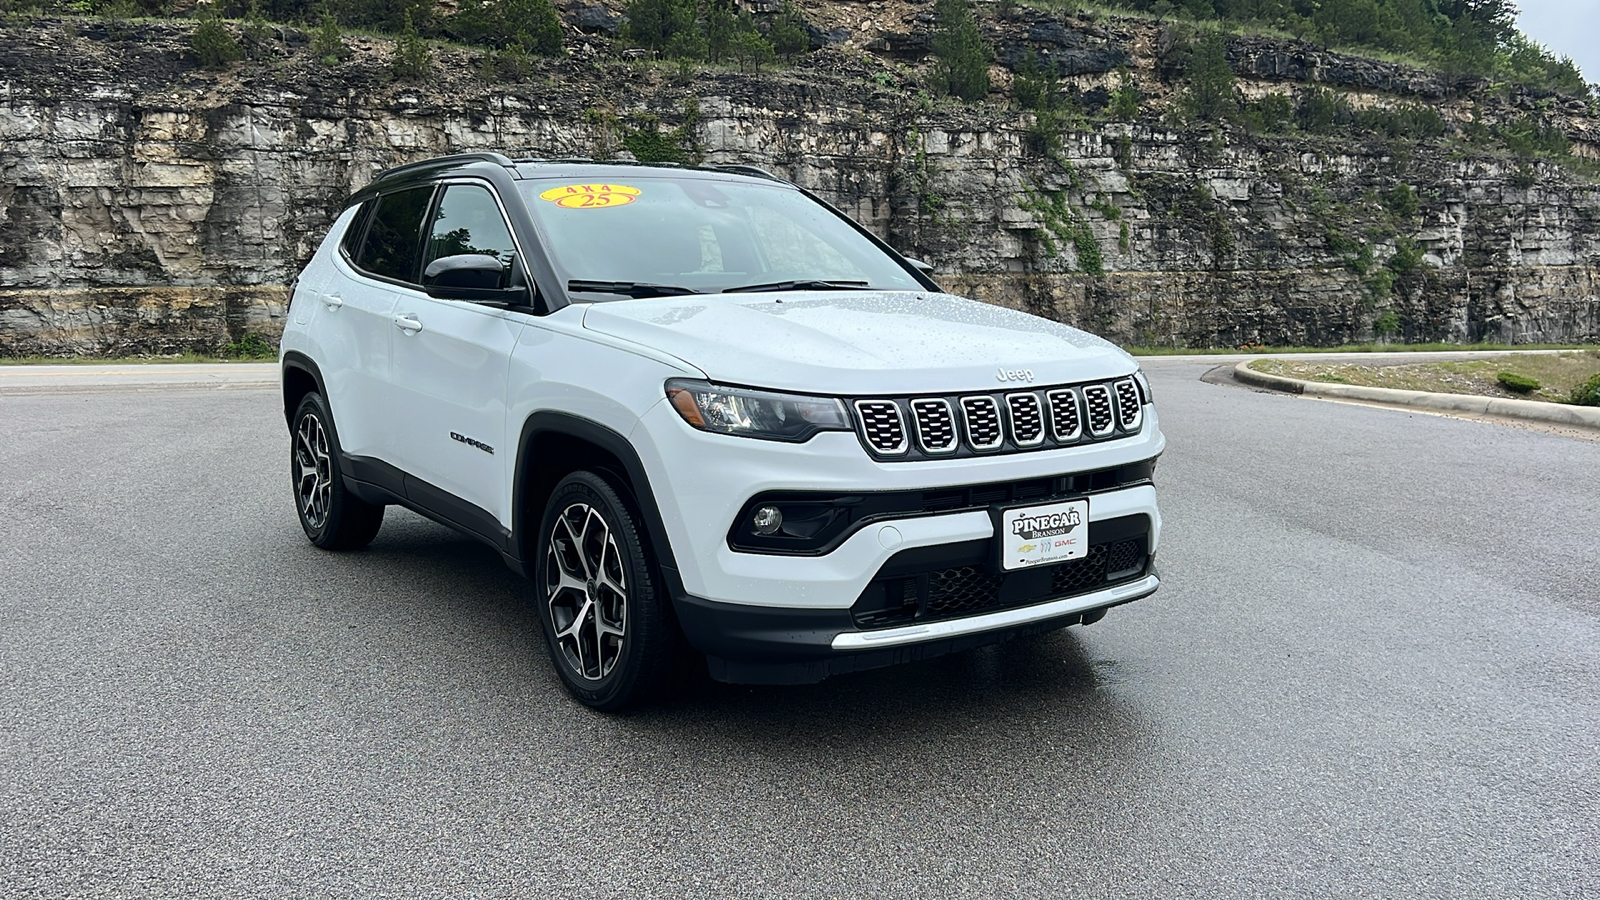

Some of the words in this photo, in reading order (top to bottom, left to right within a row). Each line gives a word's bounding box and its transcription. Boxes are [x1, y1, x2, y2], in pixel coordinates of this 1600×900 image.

[580, 193, 611, 207] 25
[996, 367, 1035, 383] Jeep
[450, 431, 494, 456] COMPASS
[1012, 511, 1081, 534] PINEGAR
[1032, 528, 1066, 539] BRANSON
[1054, 538, 1077, 548] GMC
